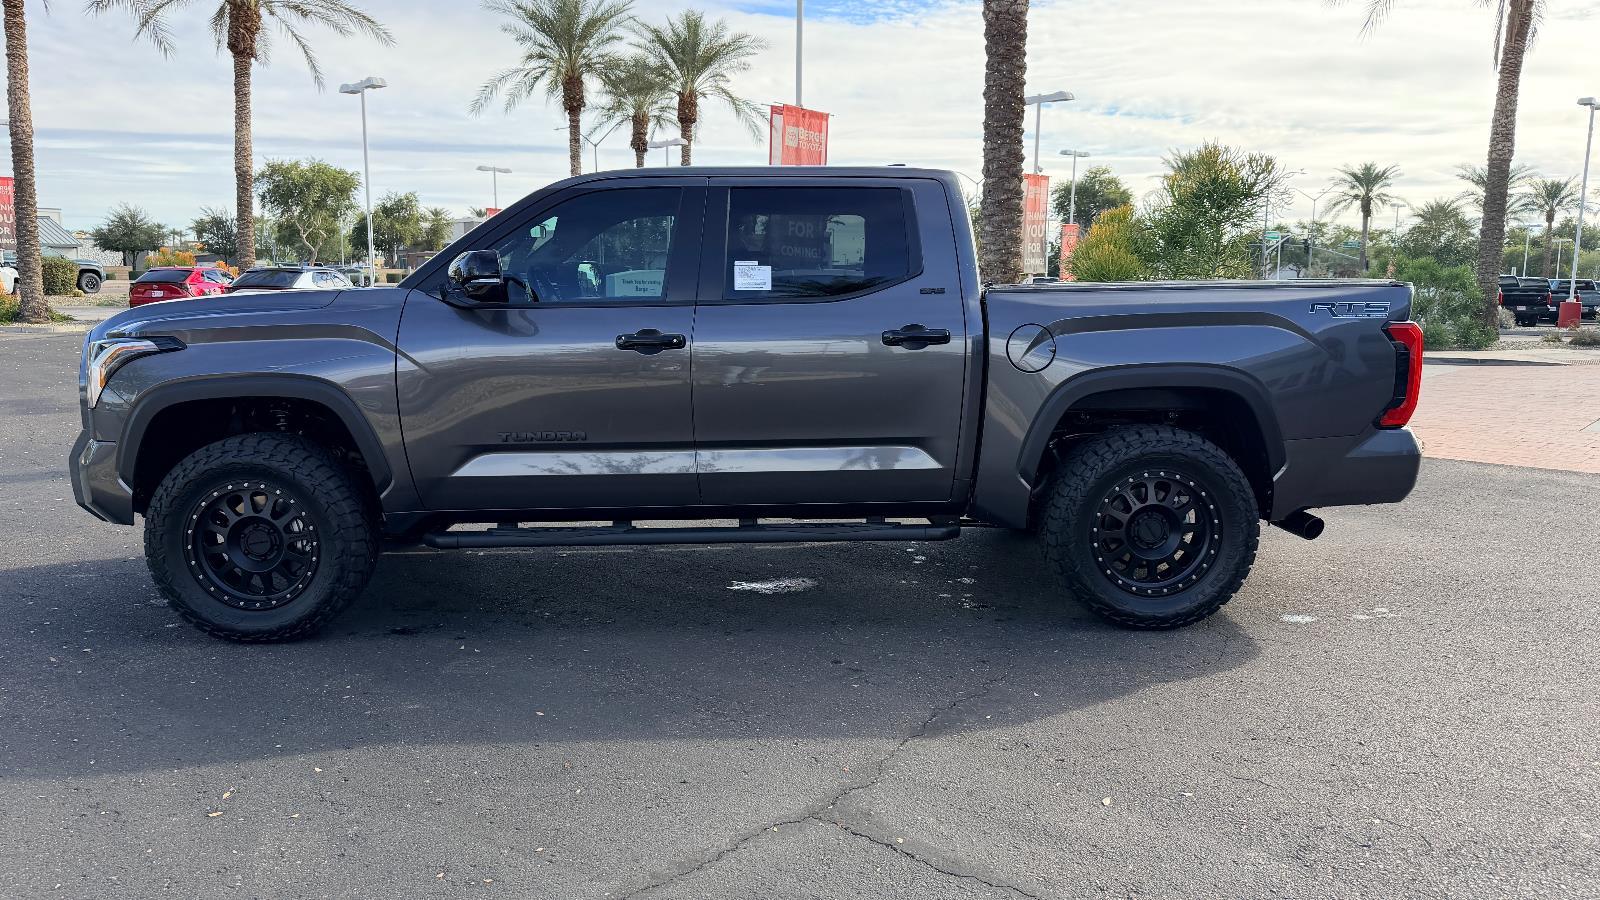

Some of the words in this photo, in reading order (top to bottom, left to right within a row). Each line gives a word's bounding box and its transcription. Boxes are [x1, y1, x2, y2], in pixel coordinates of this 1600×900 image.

[789, 220, 814, 238] FOR
[1027, 223, 1044, 238] YOU
[1028, 242, 1041, 253] FOR
[1308, 301, 1391, 319] RTS
[497, 432, 587, 442] TUNDRA
